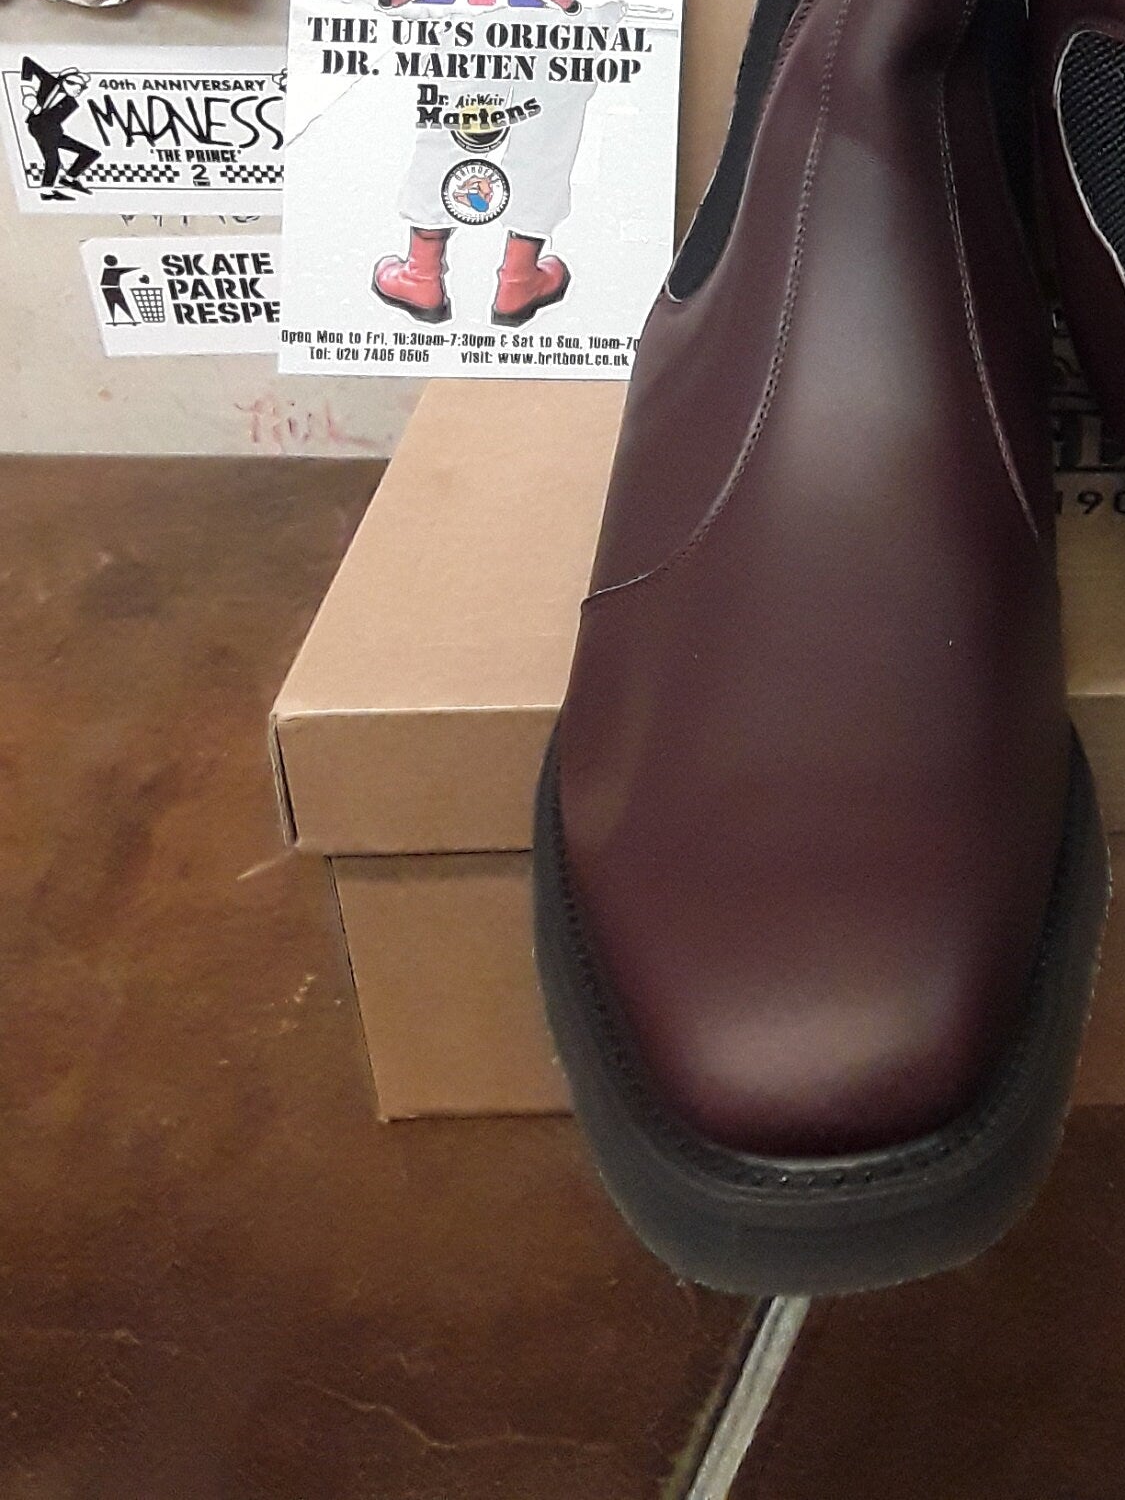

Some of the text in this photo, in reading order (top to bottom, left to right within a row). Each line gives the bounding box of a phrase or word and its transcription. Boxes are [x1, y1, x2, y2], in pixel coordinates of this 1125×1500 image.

[307, 15, 653, 54] THE UK'S ORIGINAL
[321, 48, 643, 84] DR. MARTEN SHOP
[99, 78, 267, 92] 40th ANNIVERSARY
[416, 83, 450, 106] Dr.
[86, 94, 285, 150] MADNESS
[415, 97, 542, 130] Martens
[161, 252, 275, 277] SKATE
[167, 277, 266, 300] PARK
[173, 301, 281, 325] RESPE
[281, 329, 312, 345] Open
[316, 330, 344, 345] Mon
[349, 331, 361, 345] to
[512, 333, 535, 348] Sat
[539, 335, 552, 348] to
[309, 346, 332, 361] Tel:
[337, 347, 360, 361] 020
[497, 351, 630, 367] www.britboot.co.uk
